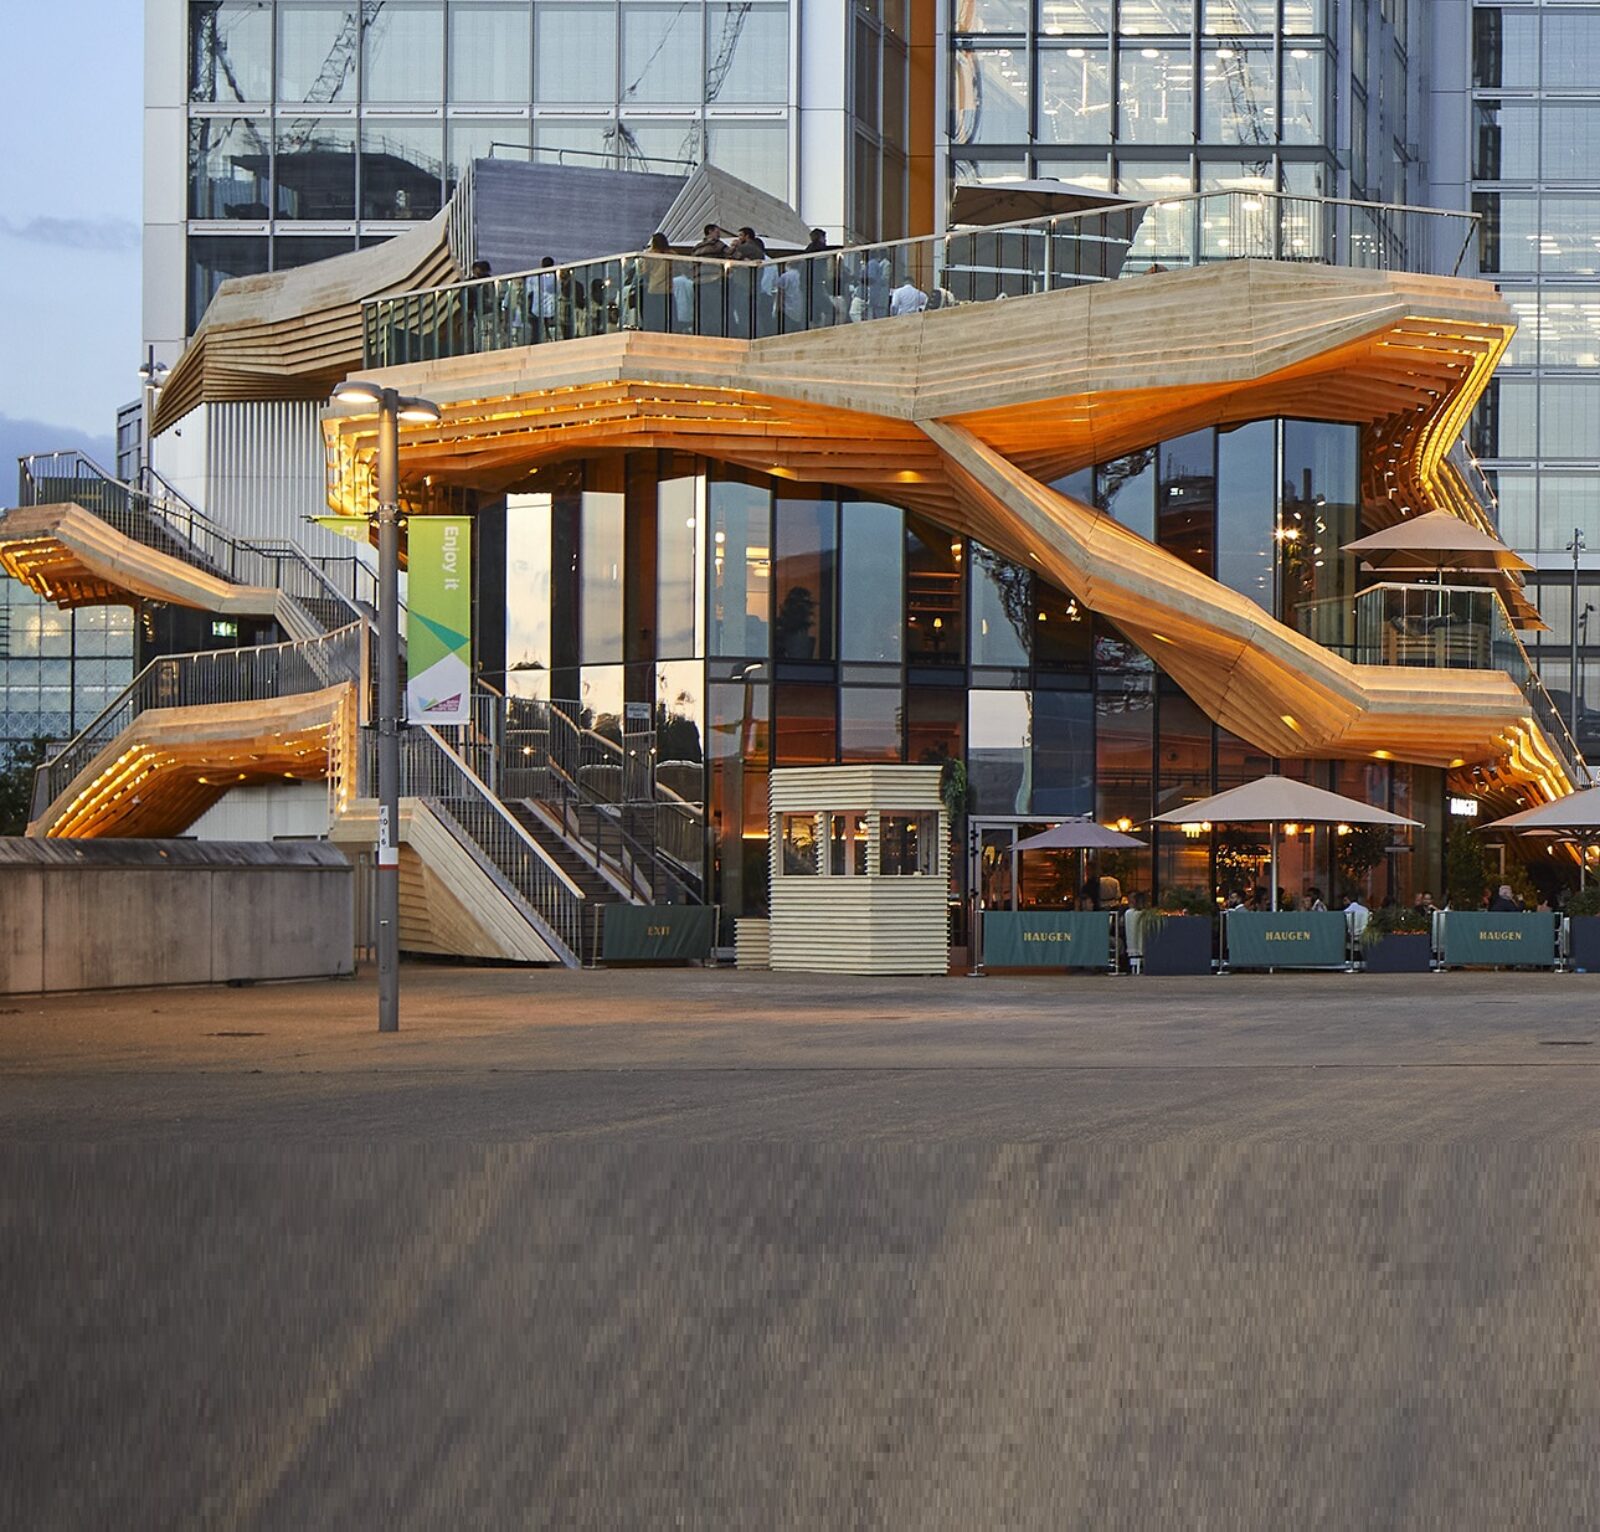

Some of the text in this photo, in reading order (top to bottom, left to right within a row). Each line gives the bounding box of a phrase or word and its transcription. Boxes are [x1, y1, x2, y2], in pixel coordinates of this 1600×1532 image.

[442, 526, 459, 590] Enjoy it
[1023, 932, 1072, 942] HAUGEN
[1265, 931, 1311, 941] HAUGEN
[1479, 931, 1521, 941] HAUGEN
